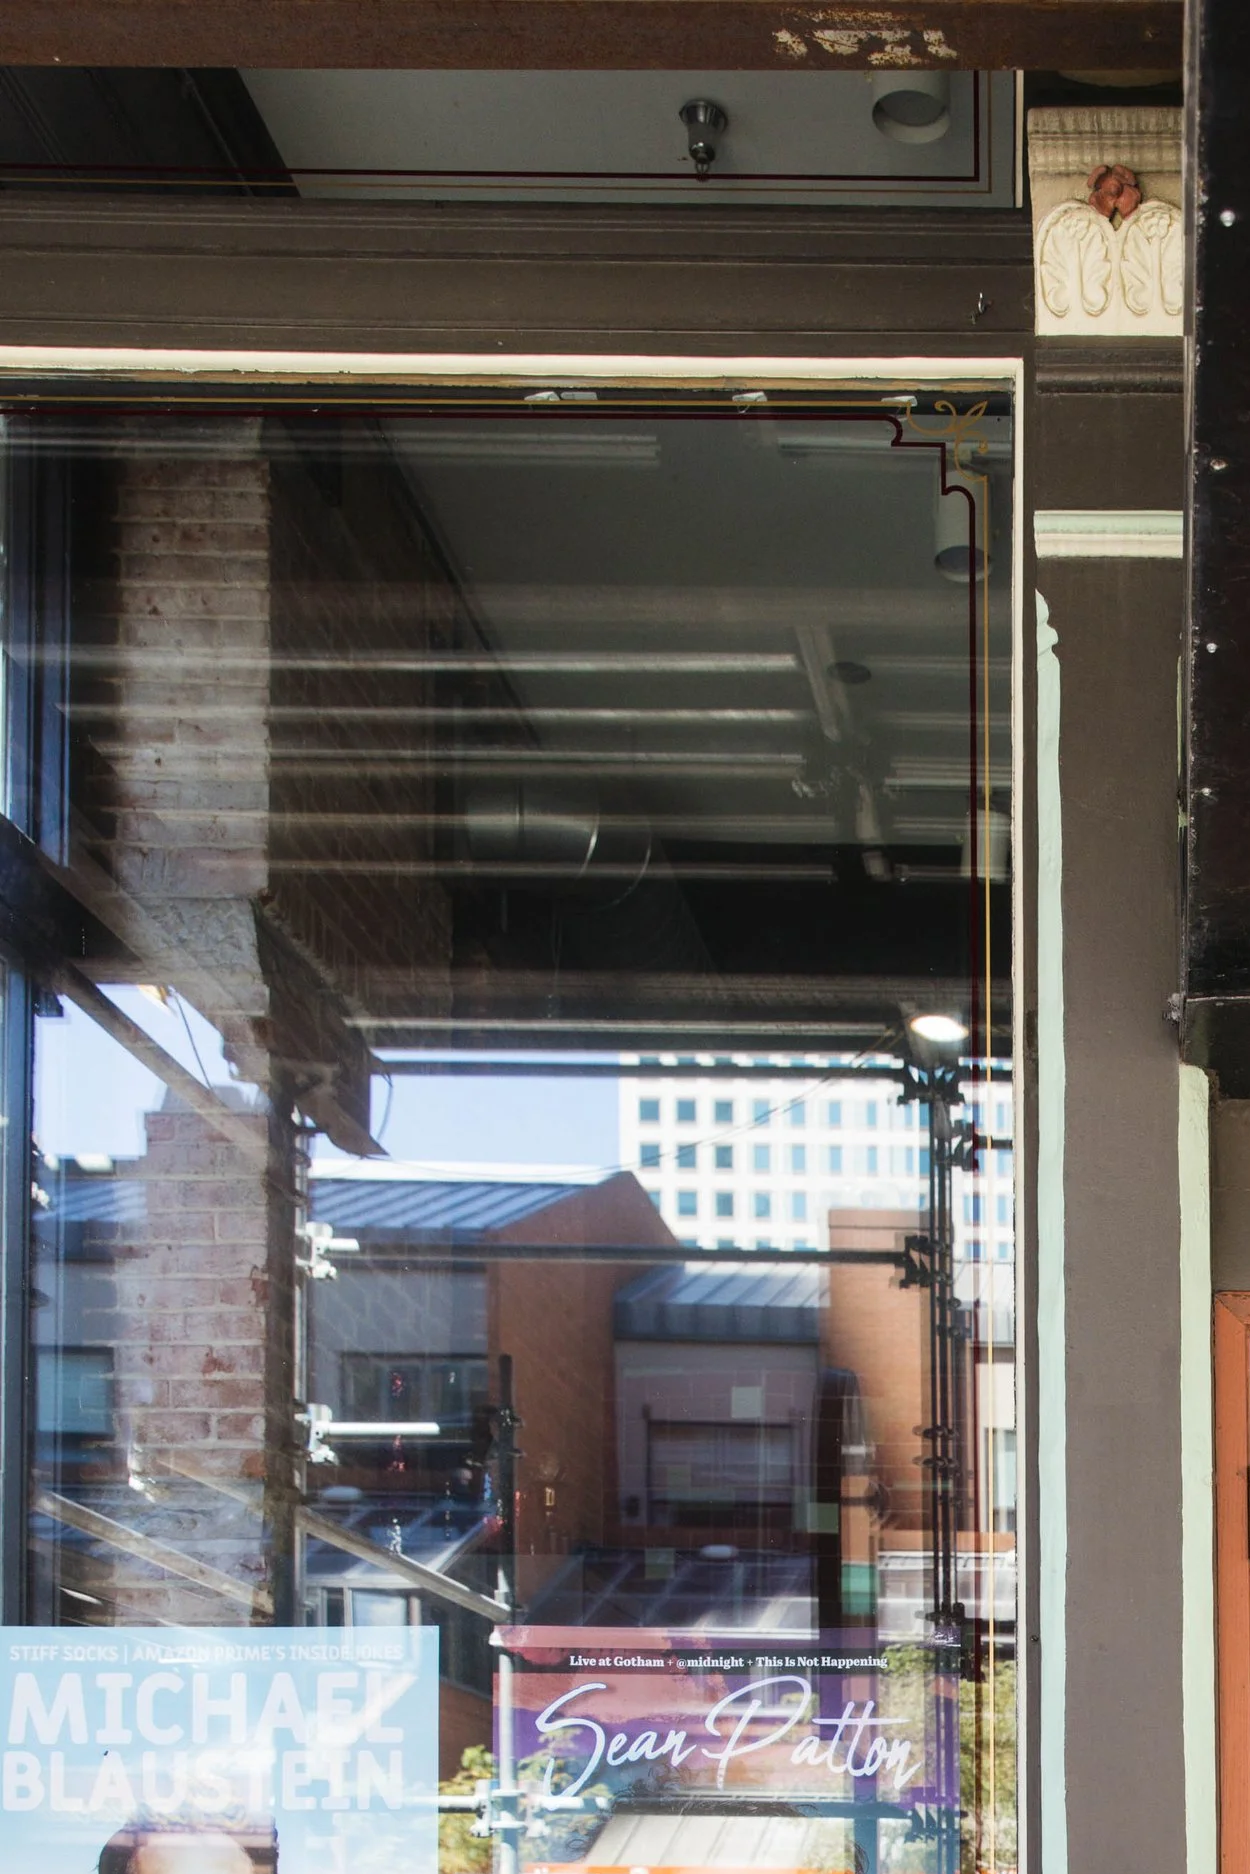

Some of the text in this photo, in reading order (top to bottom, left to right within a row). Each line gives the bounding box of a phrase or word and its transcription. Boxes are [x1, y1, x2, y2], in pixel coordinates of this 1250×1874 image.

[9, 1646, 58, 1662] STIFF
[64, 1645, 119, 1662] SOCKS
[214, 1645, 286, 1662] PRIME'S
[290, 1645, 351, 1661] INSIDE
[569, 1655, 597, 1668] Live
[599, 1656, 612, 1668] at
[613, 1655, 665, 1668] Gotham
[676, 1655, 745, 1670] @midnight
[755, 1655, 784, 1667] This
[785, 1656, 796, 1667] Is
[797, 1655, 820, 1668] Not
[821, 1655, 888, 1671] Happening
[6, 1671, 405, 1746] MICHAEL
[534, 1681, 698, 1798] Sean
[702, 1675, 923, 1791] Patton
[2, 1749, 404, 1814] BLAUSTEIN
